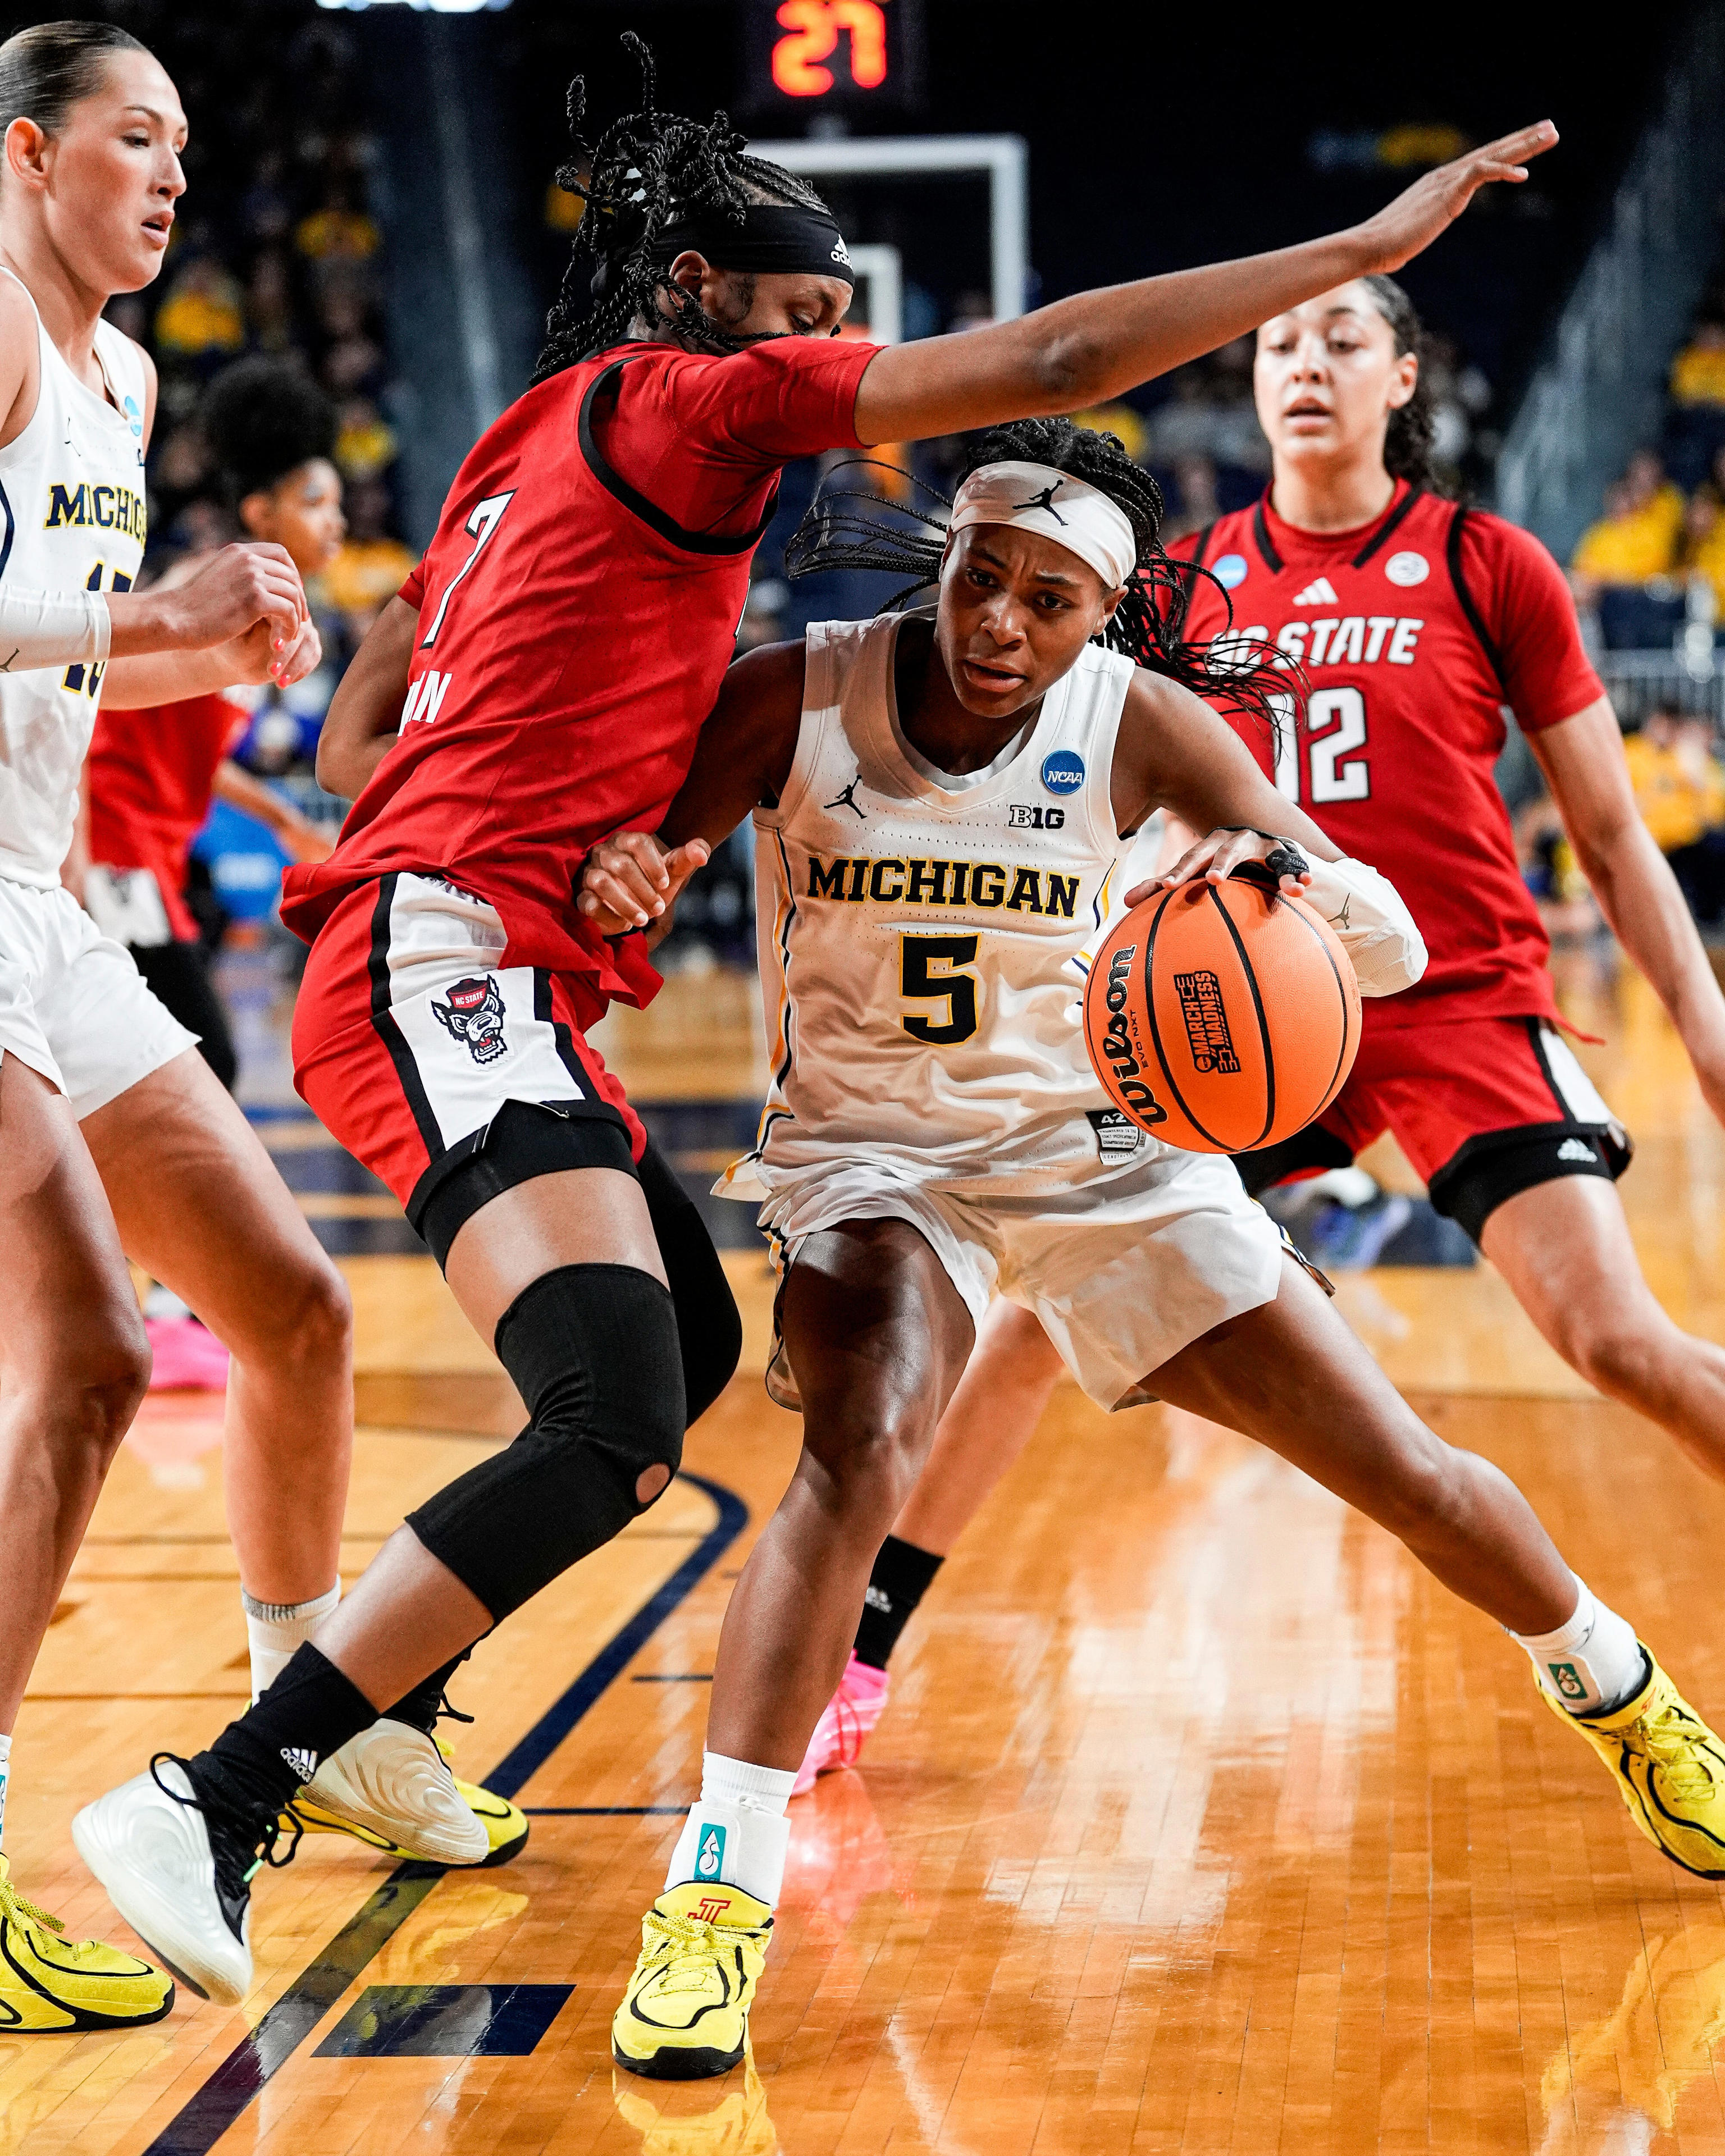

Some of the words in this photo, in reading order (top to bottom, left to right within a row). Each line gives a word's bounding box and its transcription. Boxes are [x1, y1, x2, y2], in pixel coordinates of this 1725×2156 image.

[772, 0, 887, 97] 27
[43, 482, 147, 551] MICHIG
[418, 488, 518, 650] 7
[1207, 625, 1270, 675] NC
[1271, 616, 1425, 671] STATE
[1047, 770, 1083, 784] NCAA
[1266, 686, 1370, 804] 12
[806, 855, 1081, 919] MICHIGAN
[455, 997, 465, 1006] NC
[465, 991, 483, 1004] STATE
[899, 932, 982, 1048] 5
[1194, 972, 1225, 1045] MADNESS
[1103, 944, 1169, 1127] Wilson
[1130, 1010, 1139, 1037] NXT
[1183, 1001, 1210, 1056] MARCH
[1101, 1113, 1127, 1124] 42
